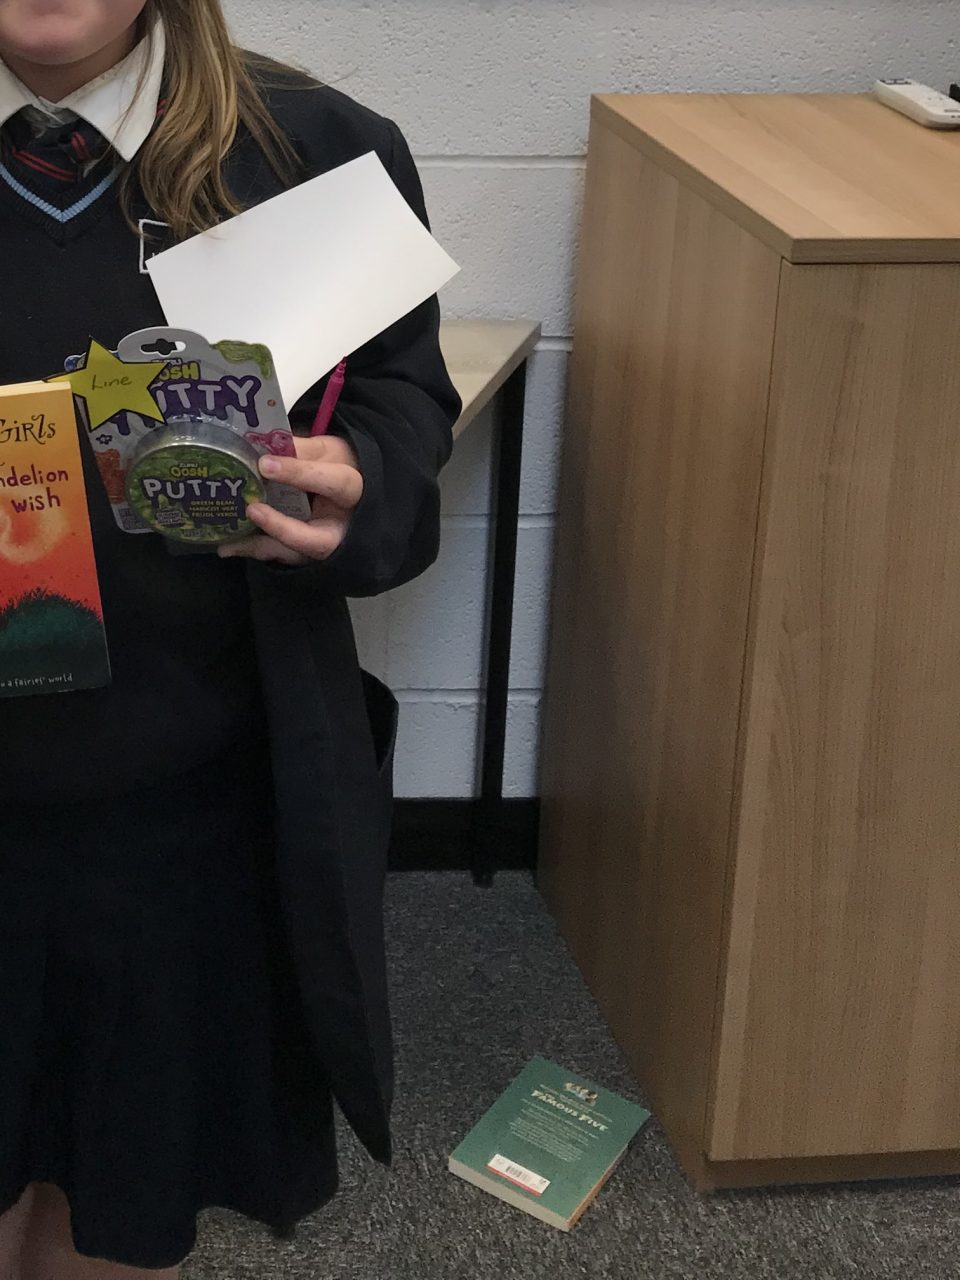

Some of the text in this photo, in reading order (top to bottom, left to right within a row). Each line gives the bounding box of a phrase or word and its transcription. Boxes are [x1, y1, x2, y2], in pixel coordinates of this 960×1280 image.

[158, 362, 200, 381] OSH
[92, 374, 132, 391] Line
[152, 378, 254, 412] TTY
[143, 478, 243, 499] PUTTY
[11, 486, 61, 514] wish
[48, 673, 73, 683] world
[579, 1114, 609, 1132] FIVE
